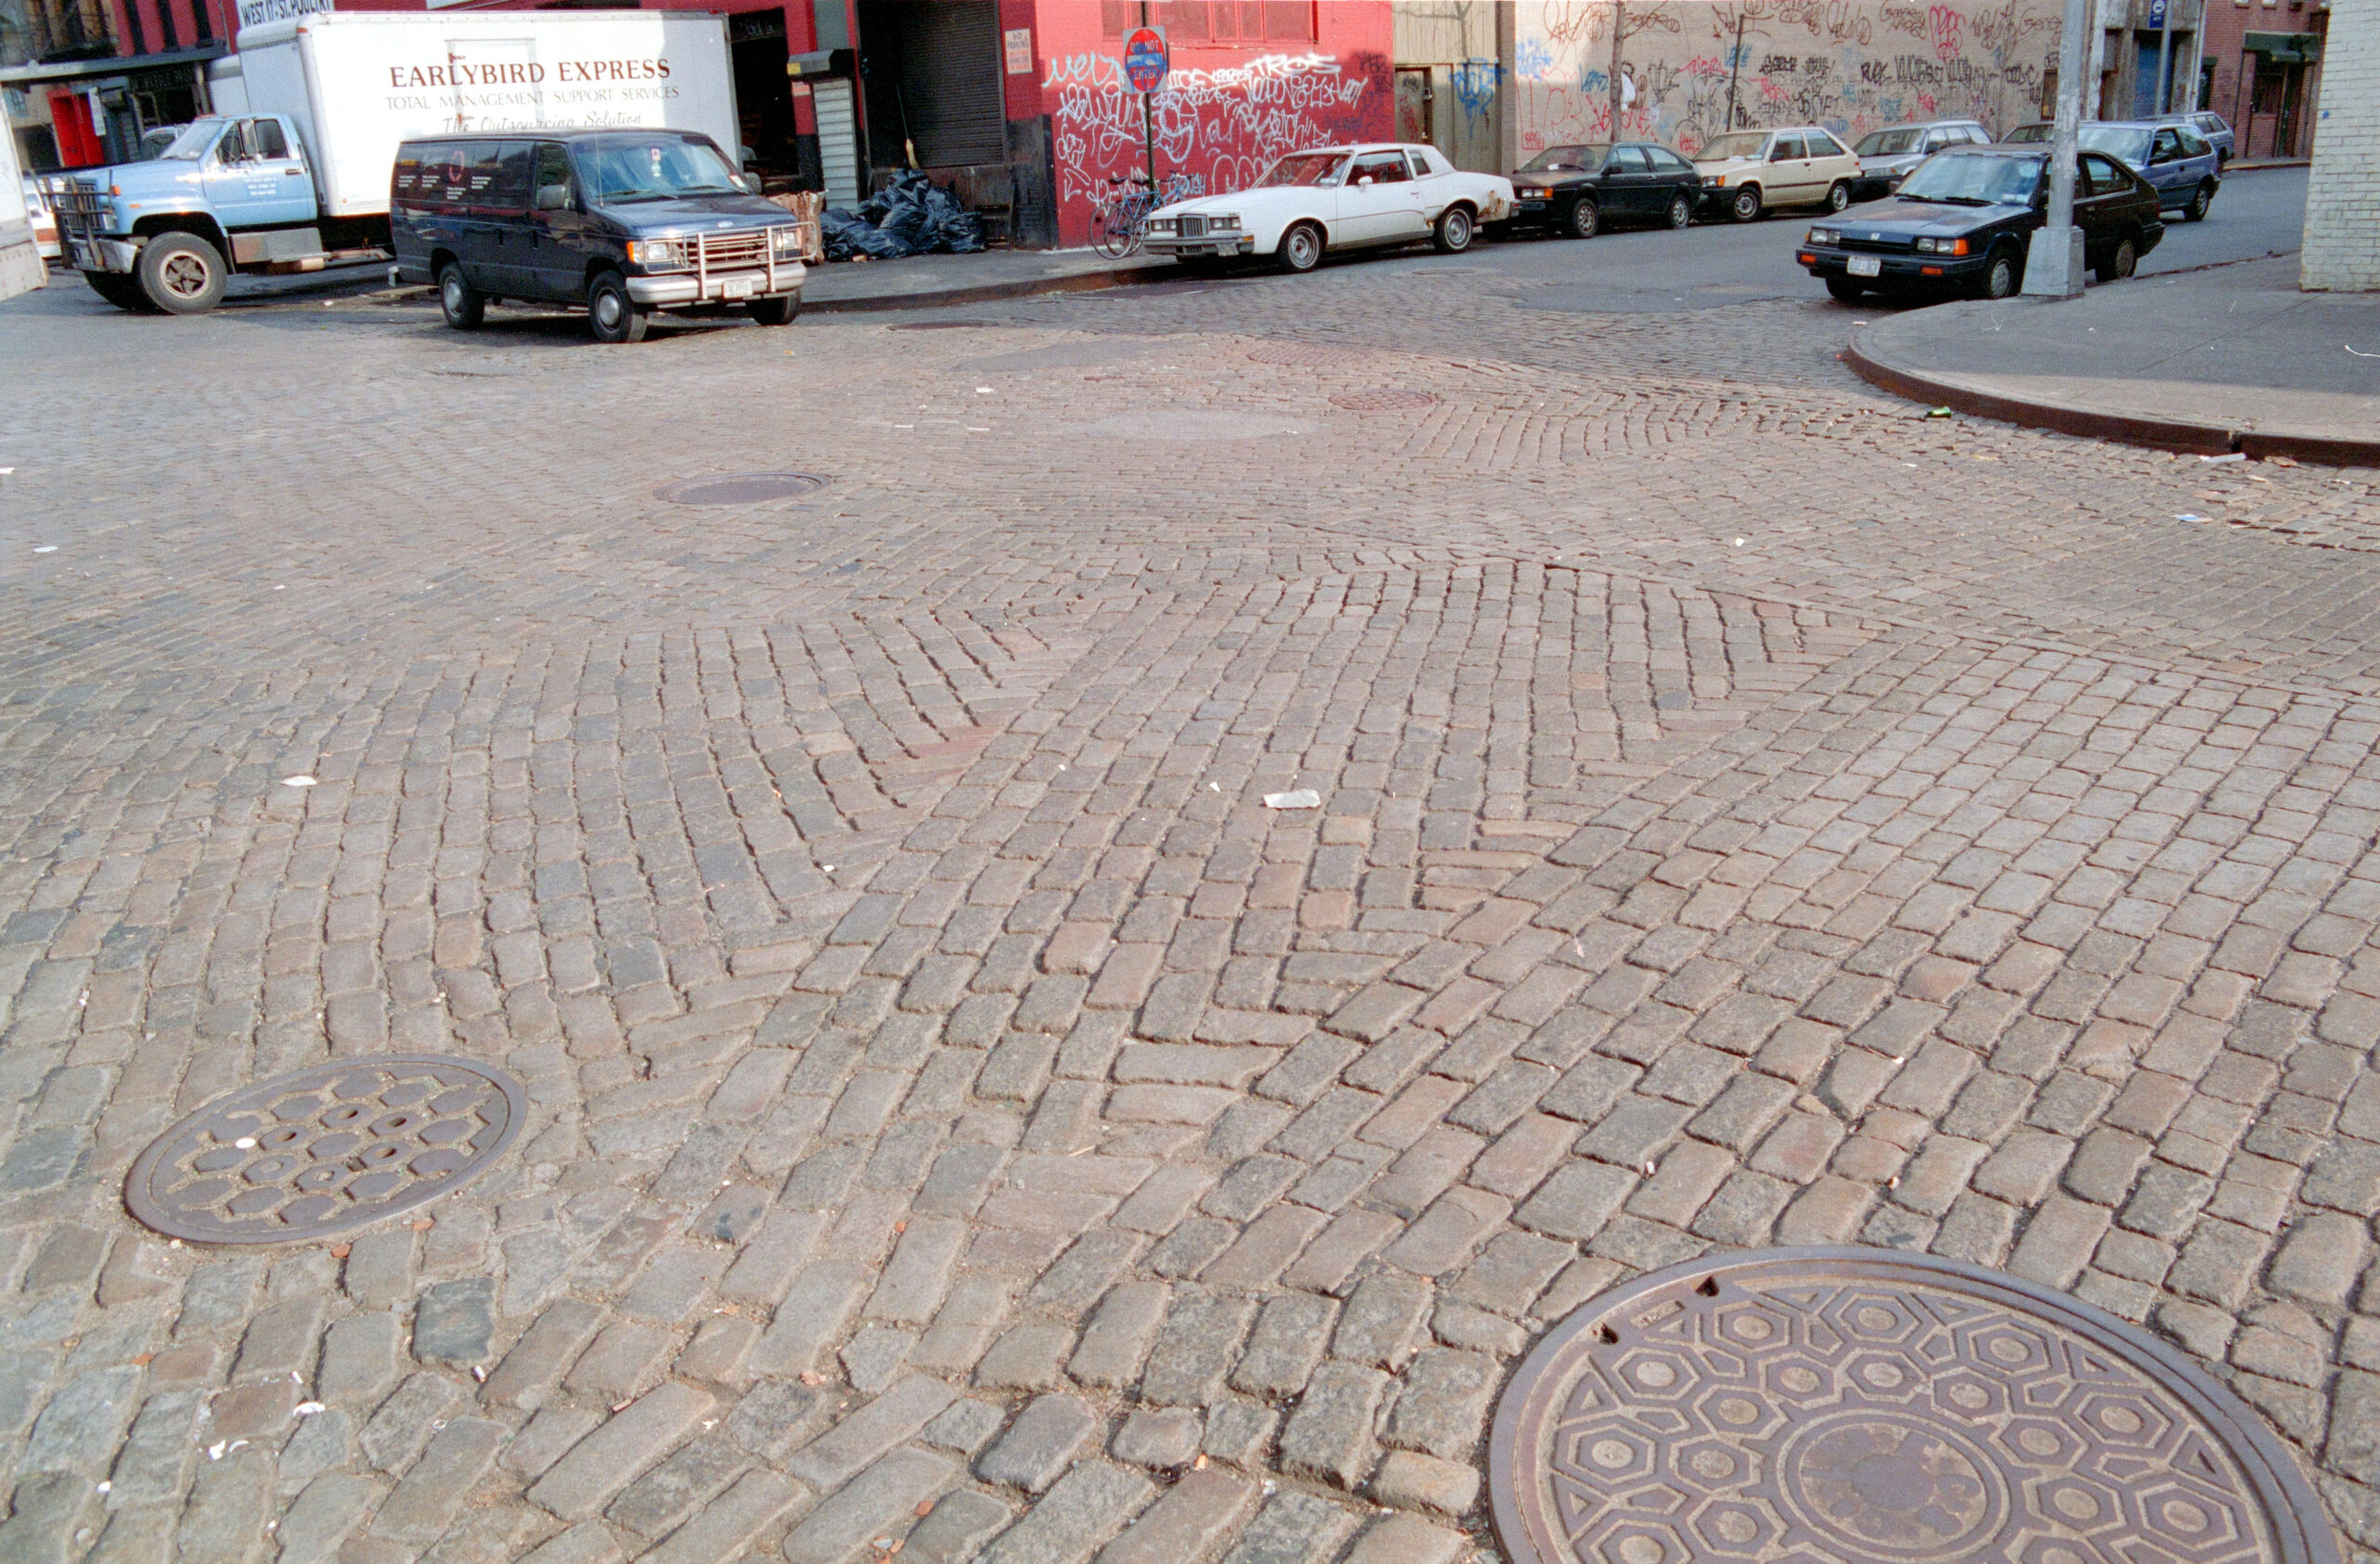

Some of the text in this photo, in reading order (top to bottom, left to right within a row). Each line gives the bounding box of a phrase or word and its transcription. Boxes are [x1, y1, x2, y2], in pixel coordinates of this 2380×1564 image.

[241, 1, 265, 27] WEST
[1144, 39, 1159, 52] NOT
[389, 58, 671, 88] EARLYBIRD EXPRESS
[1133, 68, 1157, 80] ENTER
[386, 86, 680, 111] TOTAL MANAGEMENT SUPPORT SERVICES
[584, 110, 642, 128] Solution
